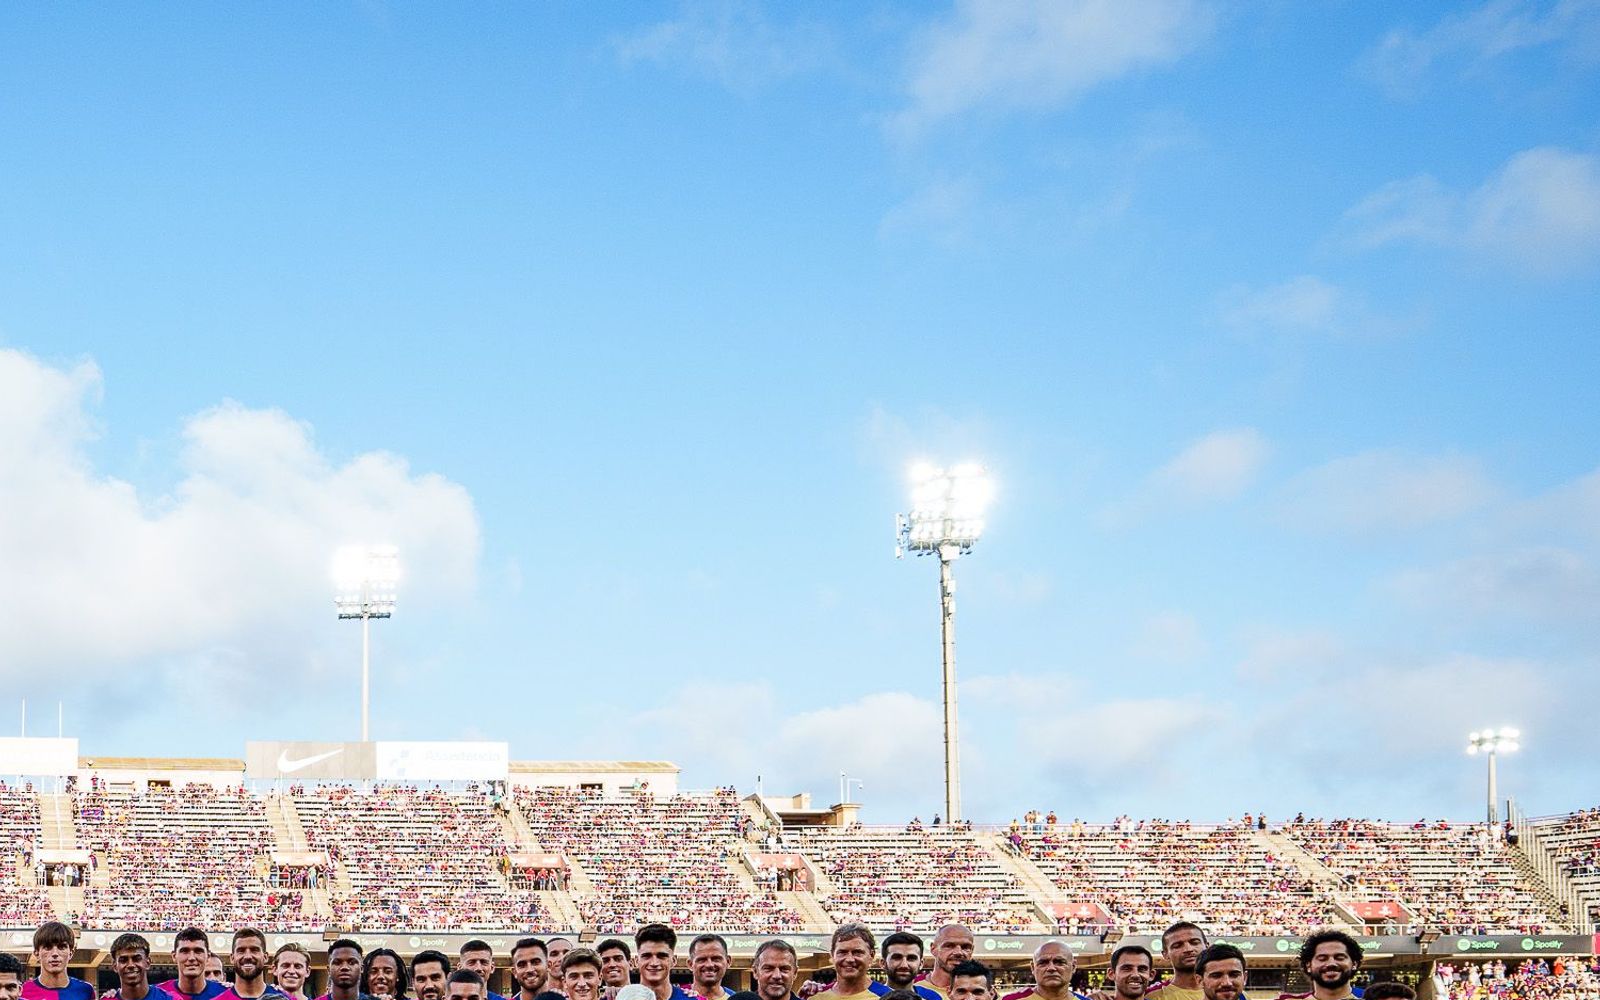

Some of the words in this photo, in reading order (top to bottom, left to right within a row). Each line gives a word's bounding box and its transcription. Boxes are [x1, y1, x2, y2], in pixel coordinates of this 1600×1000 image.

[360, 938, 387, 948] Spotify
[421, 938, 448, 949] Spotify
[796, 938, 823, 949] Spotify
[996, 940, 1024, 950] Spotify
[1470, 939, 1499, 950] Spotify
[1535, 939, 1563, 949] Spotify
